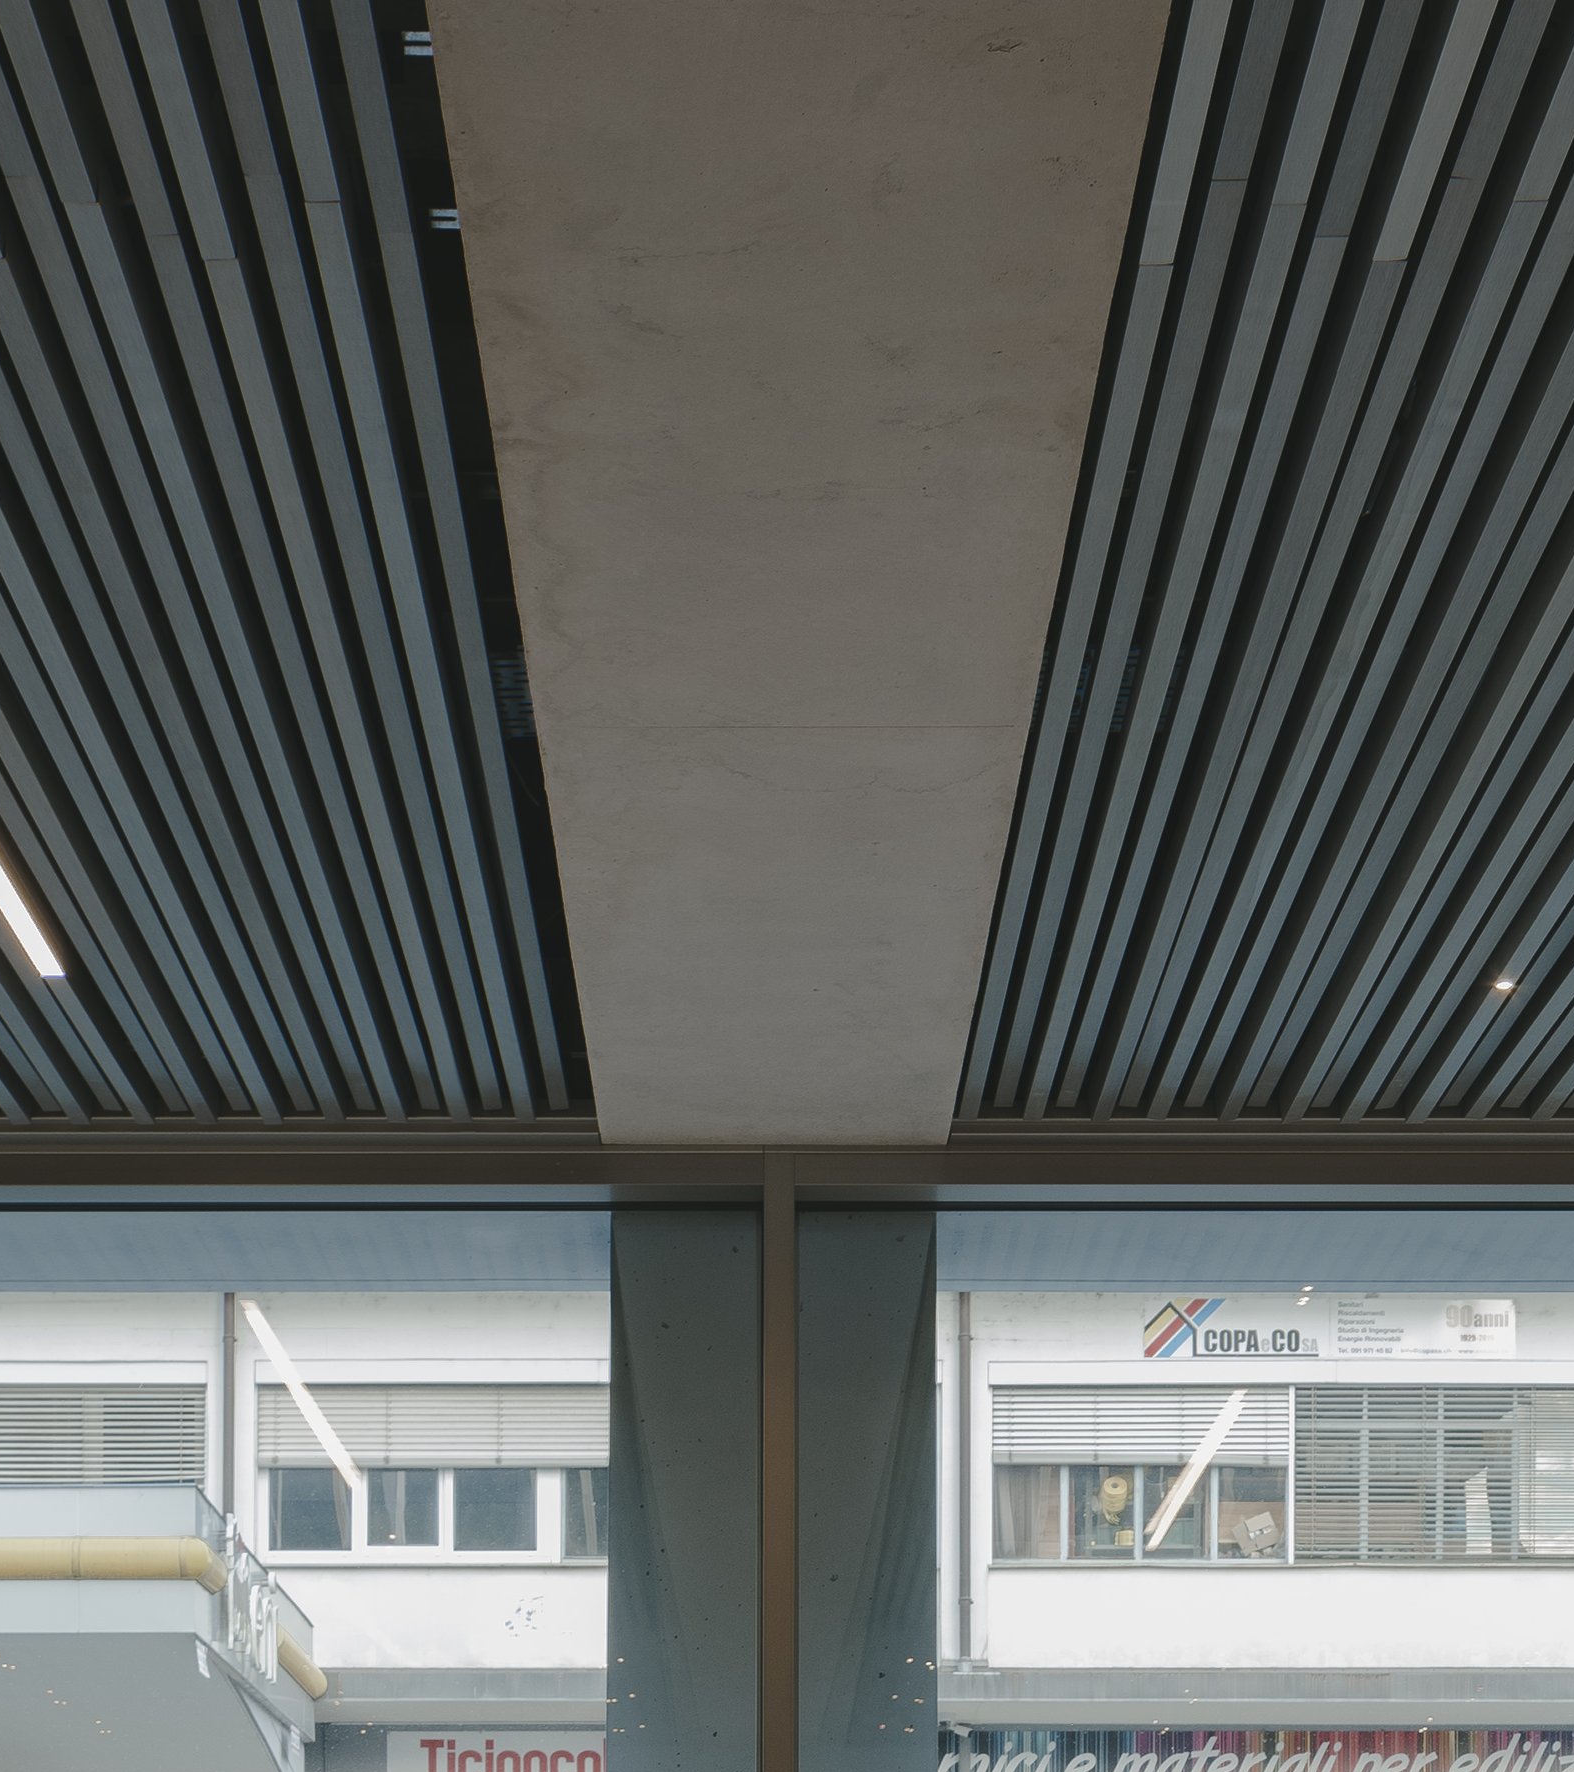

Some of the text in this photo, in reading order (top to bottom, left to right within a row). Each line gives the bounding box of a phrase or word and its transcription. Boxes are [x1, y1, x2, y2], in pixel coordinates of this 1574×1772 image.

[1337, 1309, 1386, 1317] Riscaldamenti
[1337, 1317, 1376, 1326] Riparazioni
[1337, 1326, 1360, 1334] Studio
[1368, 1326, 1405, 1335] Ingegneria
